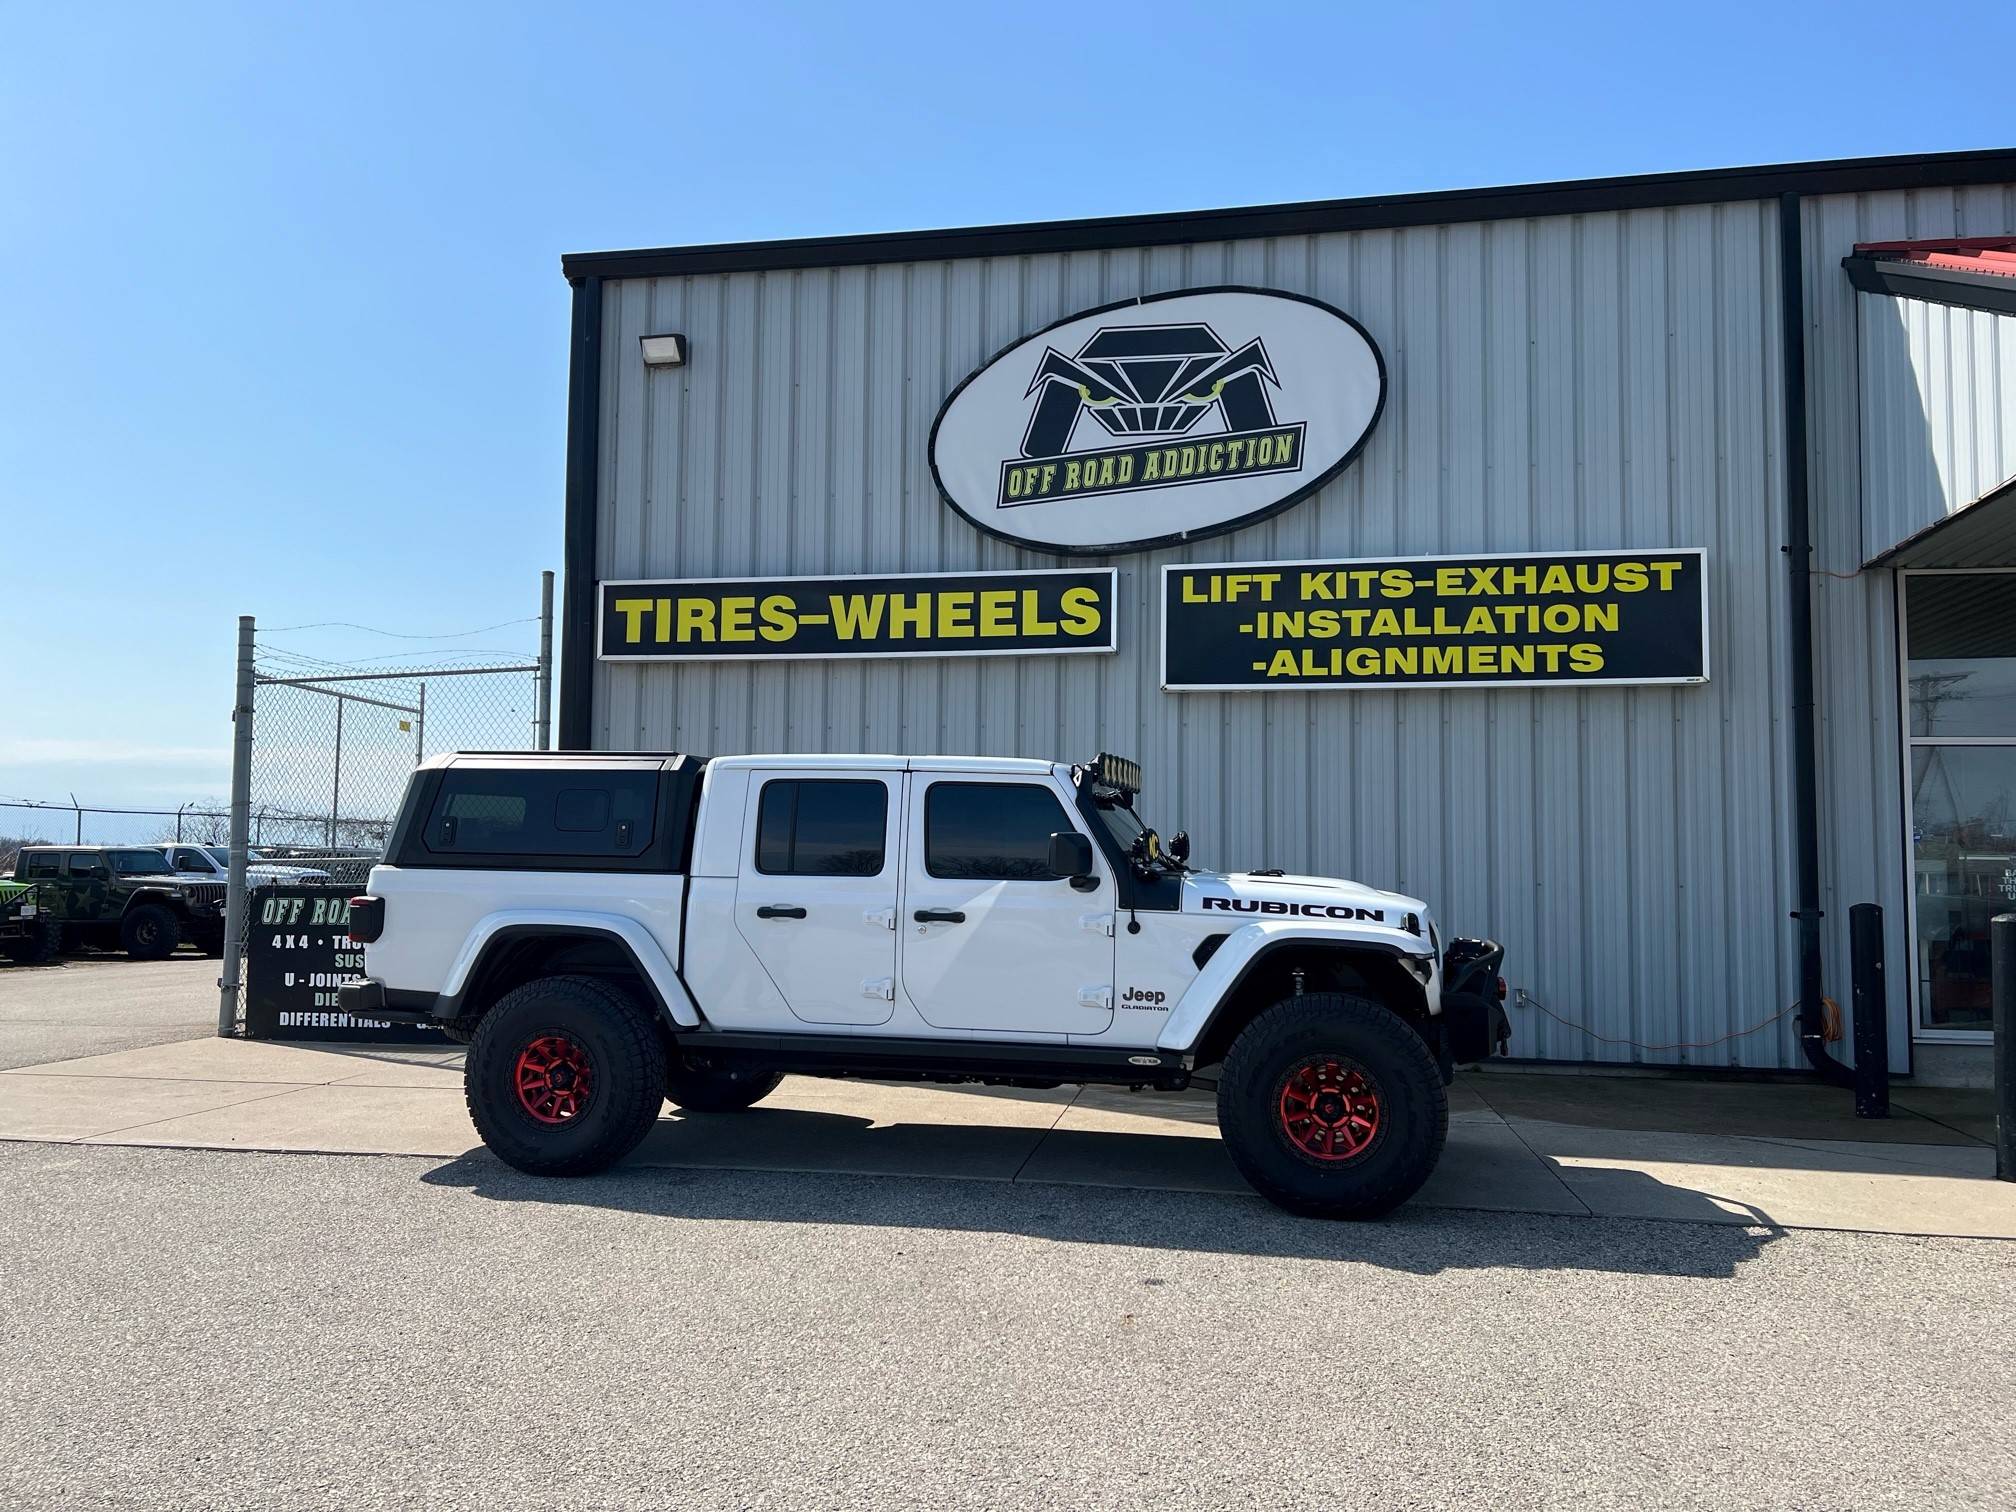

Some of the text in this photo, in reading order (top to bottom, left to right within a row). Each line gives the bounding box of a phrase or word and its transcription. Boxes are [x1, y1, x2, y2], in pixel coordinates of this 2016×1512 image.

[1007, 432, 1295, 499] OFF ROAD ADDICTION
[1182, 561, 1682, 603] LIFT KITS-EXHAUST
[615, 587, 1101, 643] TIRES-WHEELS
[1239, 603, 1619, 639] -INSTALLATION
[1252, 643, 1605, 677] -ALIGNMENTS
[262, 898, 305, 925] OFF
[1202, 897, 1384, 922] RUBICON
[1121, 1004, 1169, 1012] GLADIATOR
[1122, 987, 1165, 1005] Jeep
